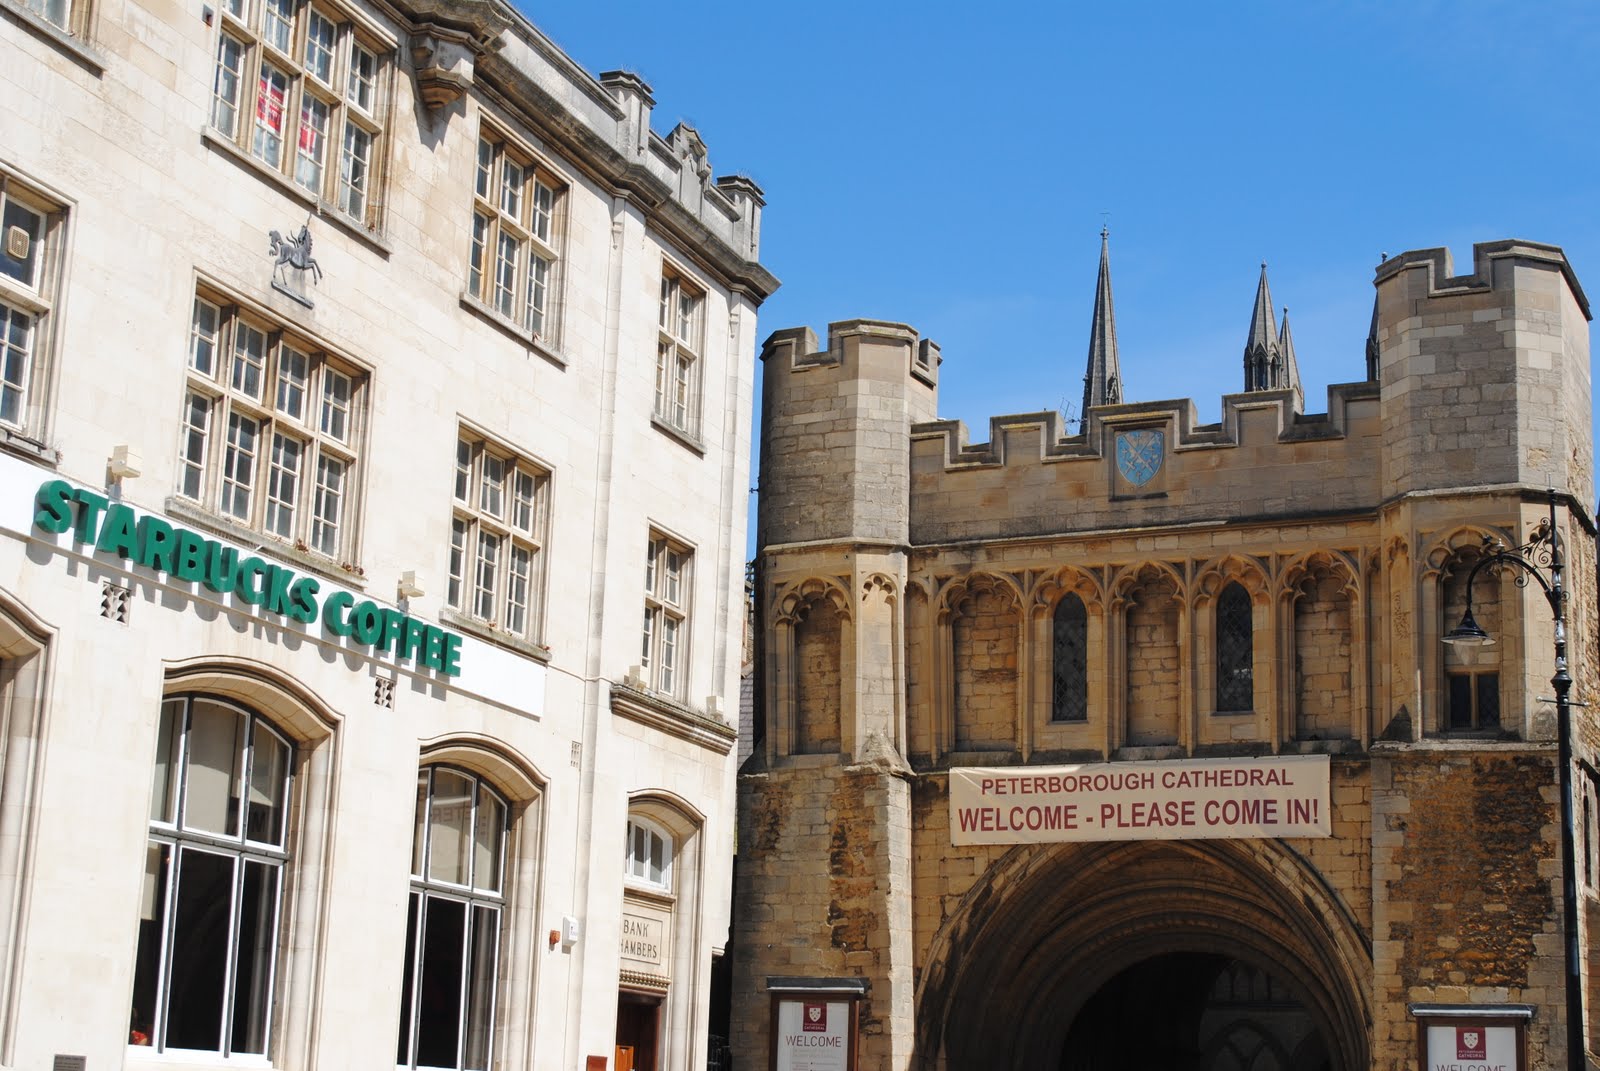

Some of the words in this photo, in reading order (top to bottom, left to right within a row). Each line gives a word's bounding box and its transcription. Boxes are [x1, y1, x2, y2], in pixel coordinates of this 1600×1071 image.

[35, 480, 320, 624] STARBUCKS
[323, 591, 463, 677] COFFEE
[982, 772, 1155, 795] PETERBOROUGH
[1162, 769, 1294, 789] CATHEDRAL
[959, 804, 1078, 832] WELCOME
[1101, 801, 1196, 828] PLEASE
[1204, 799, 1278, 825] COME
[1287, 799, 1319, 824] IN!
[623, 919, 649, 938] BANK
[785, 1035, 842, 1048] WELCOME
